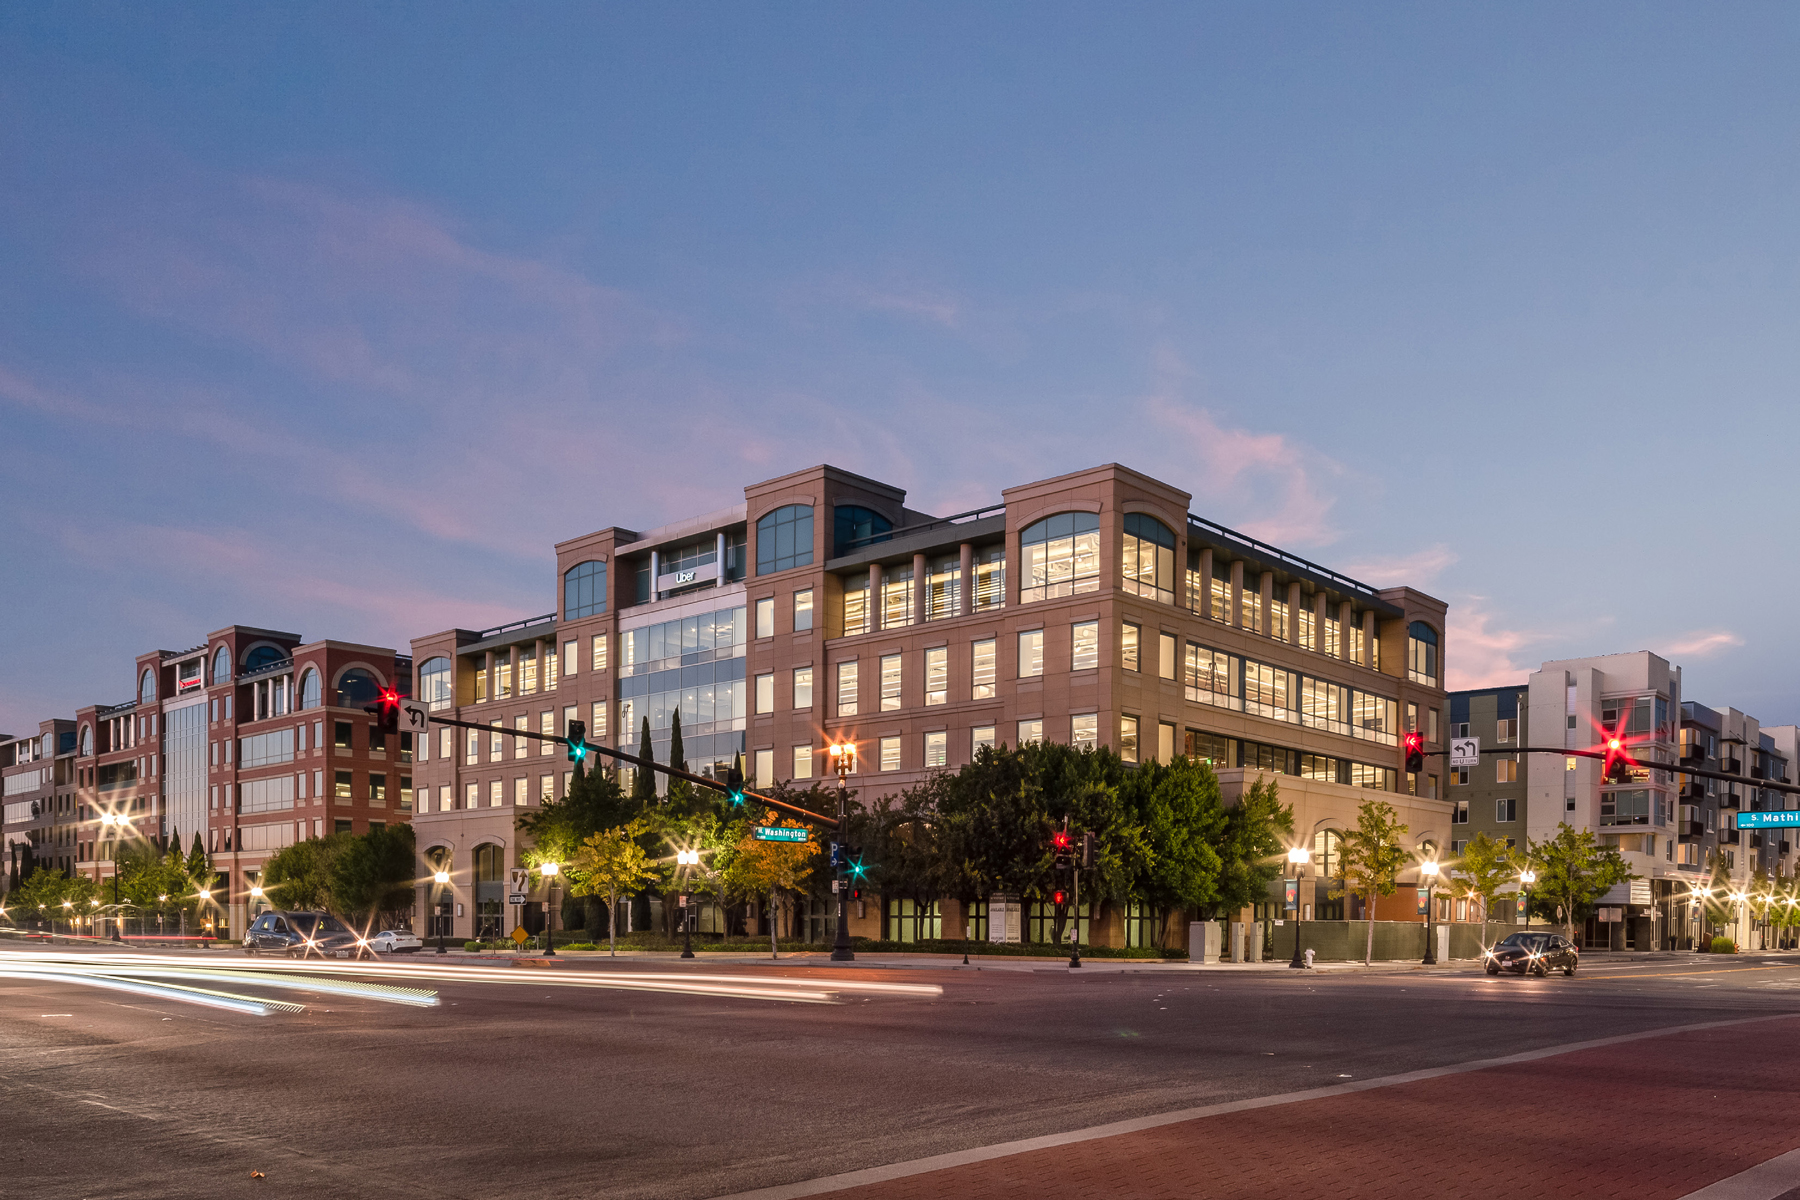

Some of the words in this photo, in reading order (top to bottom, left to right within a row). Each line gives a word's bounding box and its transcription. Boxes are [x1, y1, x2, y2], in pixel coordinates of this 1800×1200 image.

[676, 571, 695, 583] Uber
[765, 829, 806, 838] Washington
[831, 843, 838, 857] P
